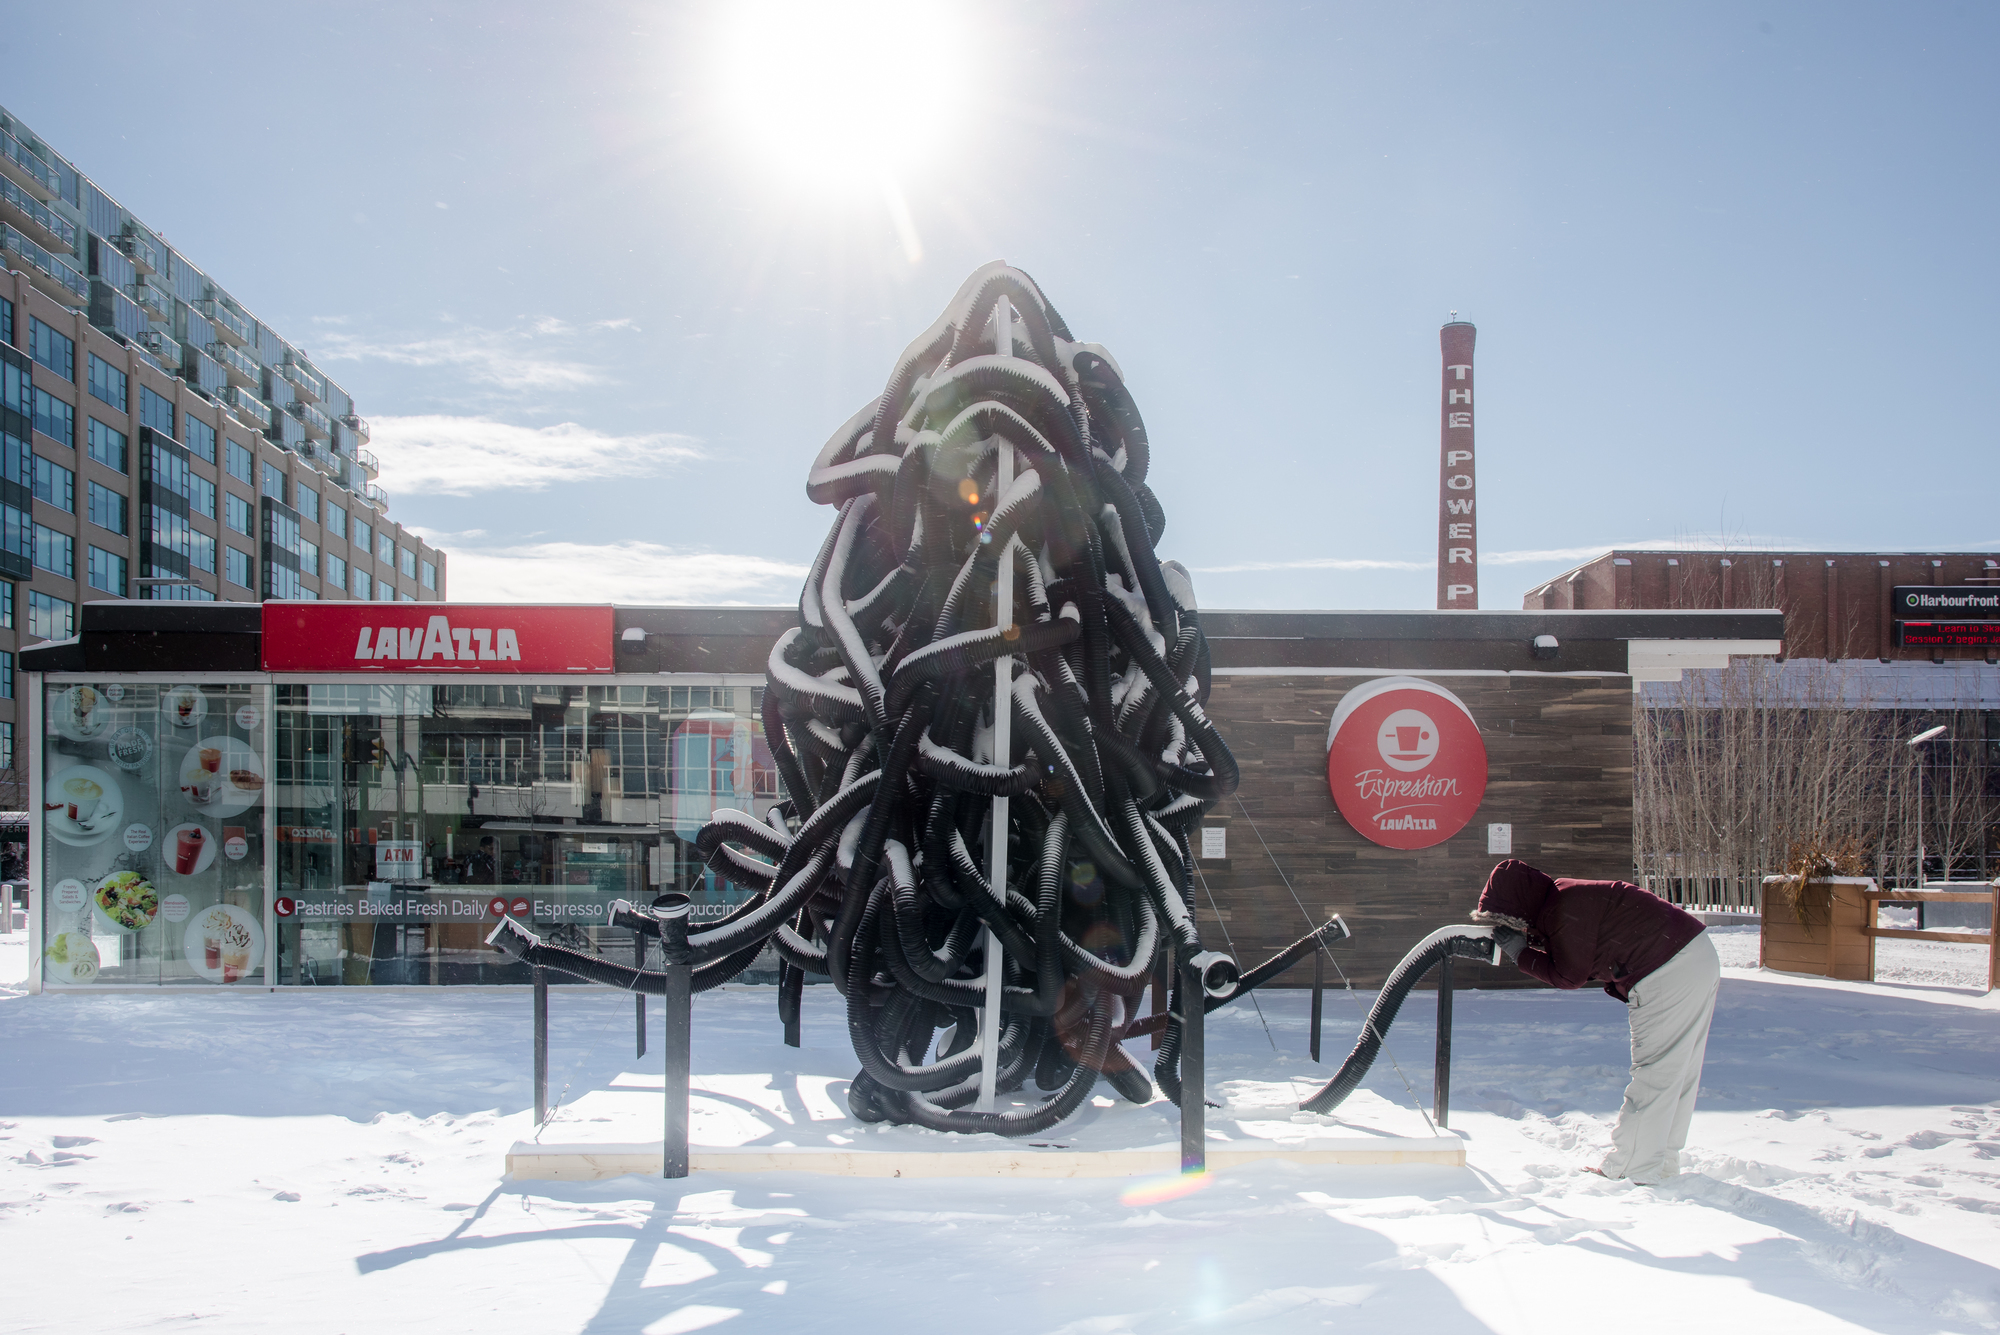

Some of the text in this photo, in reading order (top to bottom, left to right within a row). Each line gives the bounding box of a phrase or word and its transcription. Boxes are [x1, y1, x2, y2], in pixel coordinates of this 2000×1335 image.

[1447, 364, 1472, 428] THE
[1447, 450, 1474, 564] POWER
[1920, 594, 1999, 607] Harbourfront
[1938, 624, 1967, 633] Learn
[354, 615, 521, 661] LAVAZZA
[1905, 635, 1943, 644] Session
[1946, 635, 1953, 644] 2
[1956, 635, 1988, 646] begins
[117, 738, 142, 751] MADE
[118, 744, 144, 757] FRESH
[1380, 814, 1437, 830] LAVAZZA
[384, 849, 413, 862] ATM
[294, 900, 487, 920] Pastries Baked Fresh Daily
[533, 900, 602, 920] Espresso
[607, 900, 655, 916] Cffee
